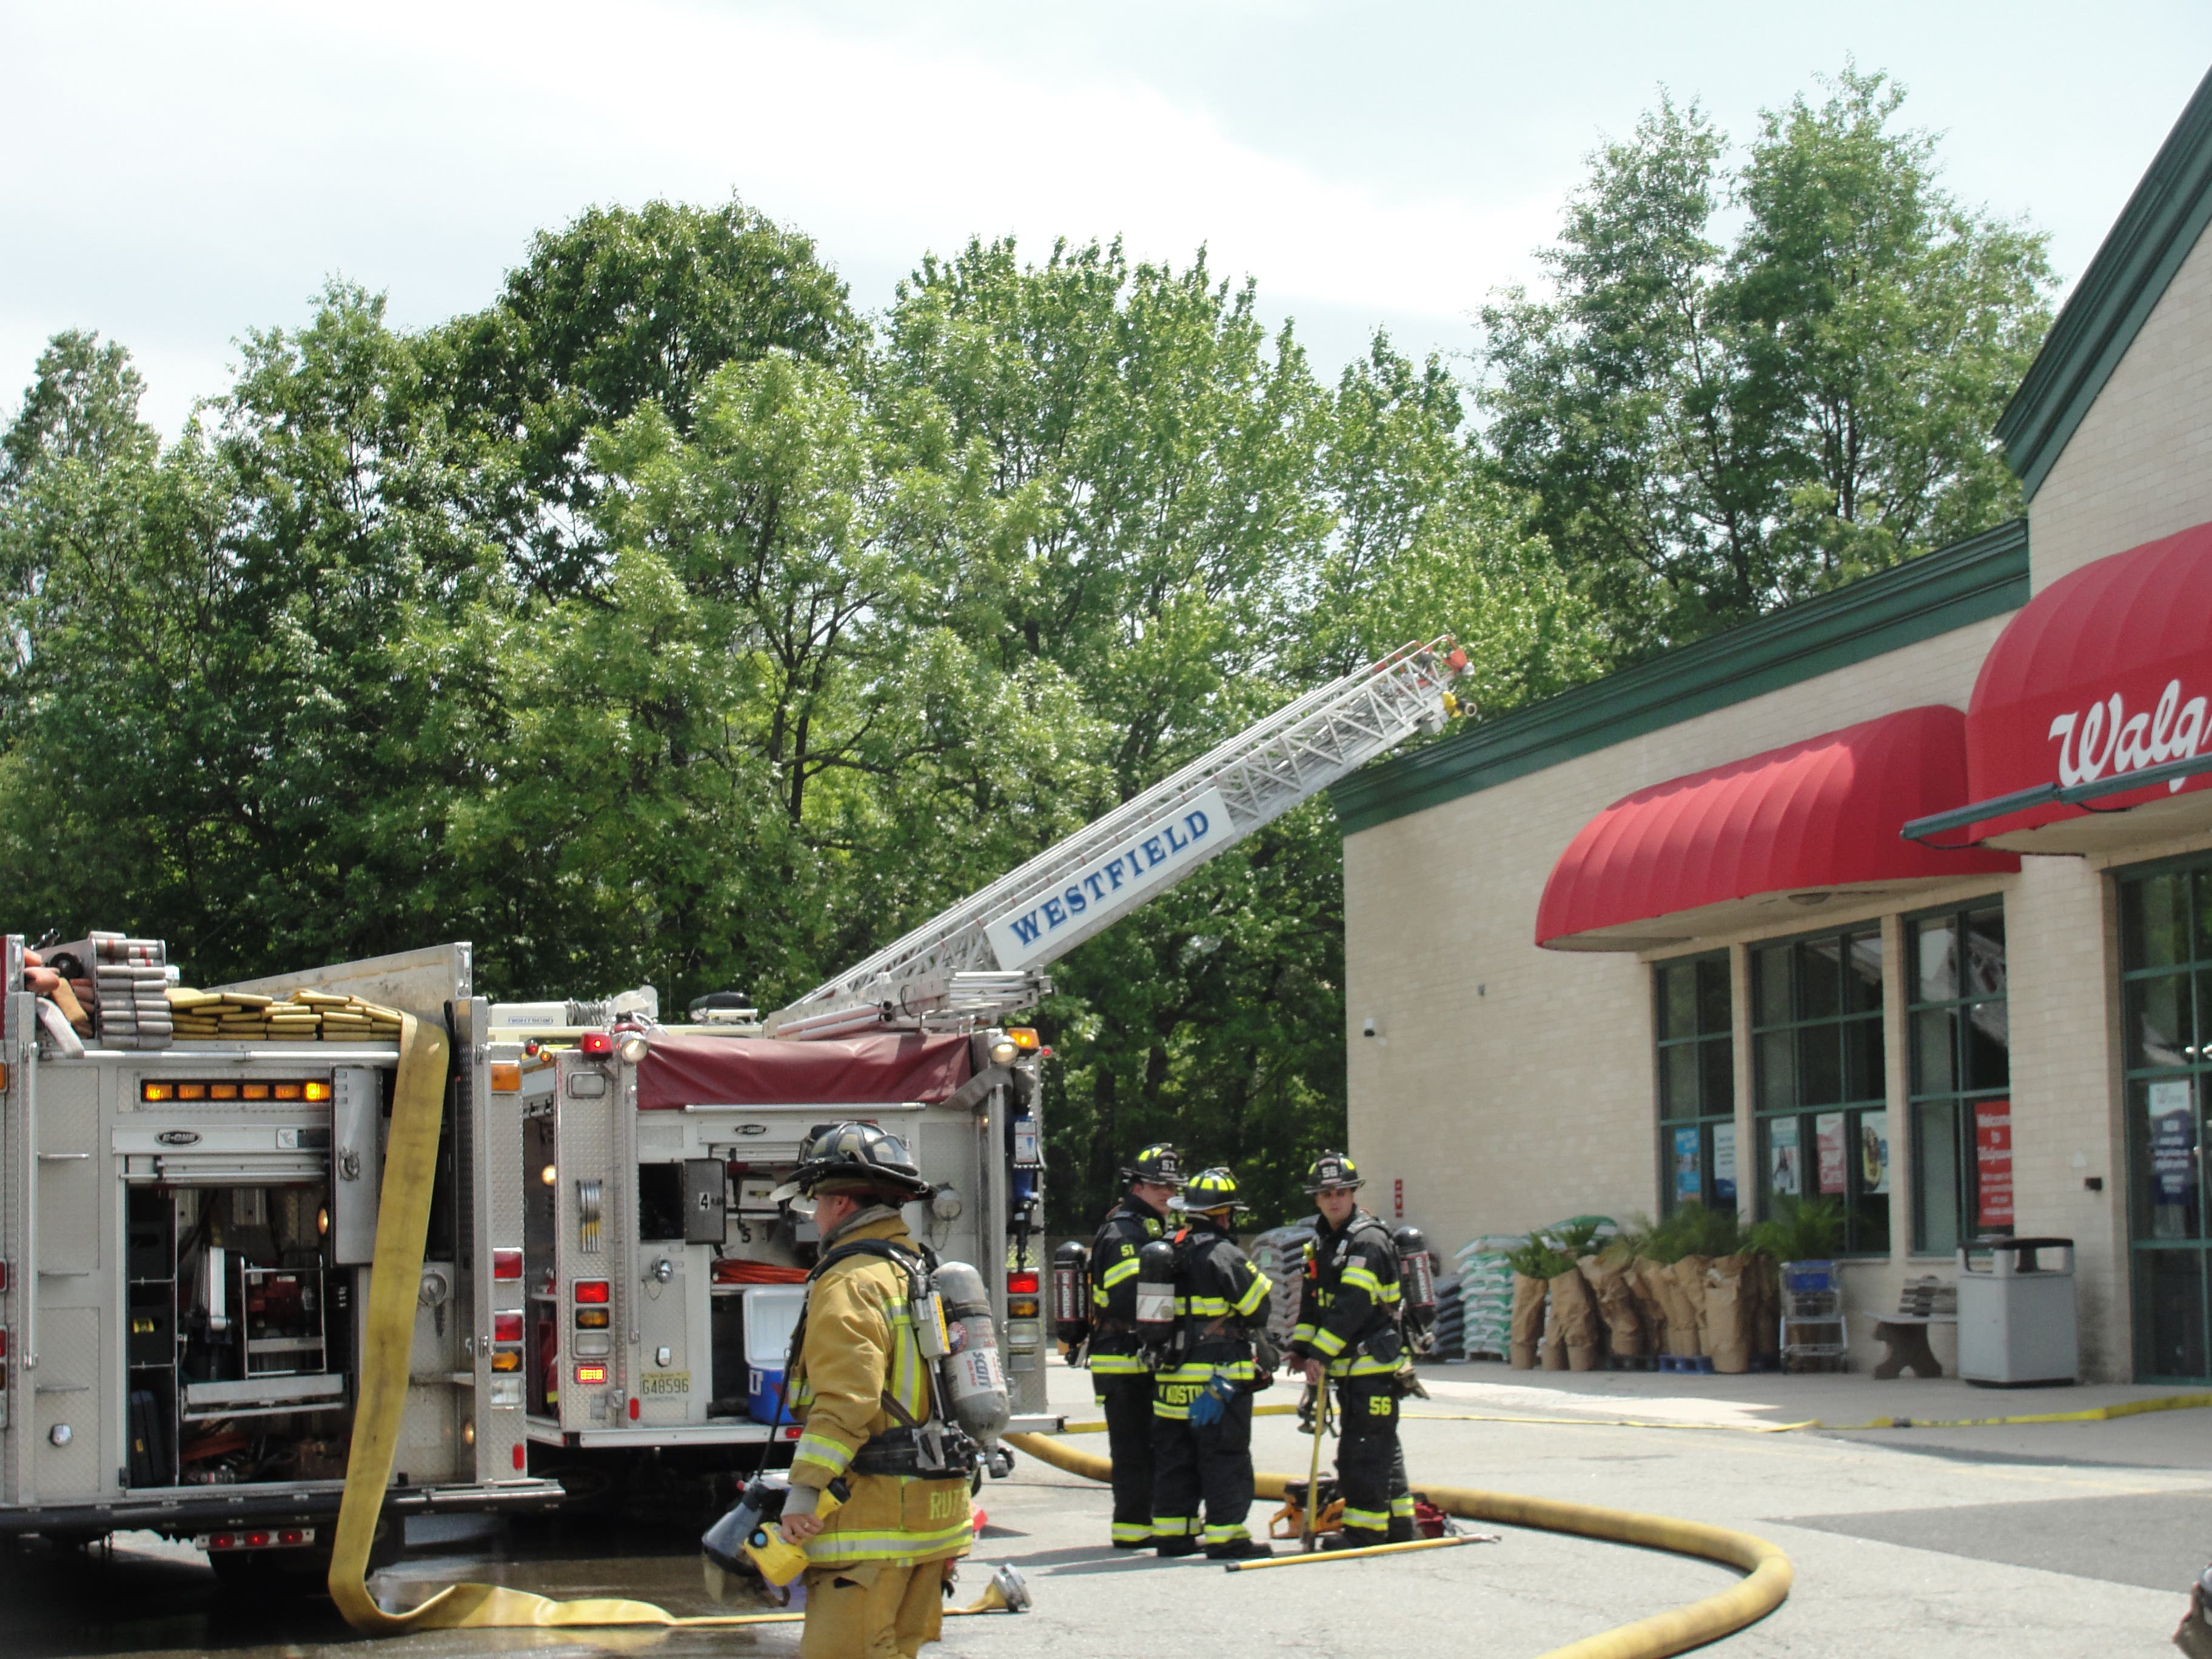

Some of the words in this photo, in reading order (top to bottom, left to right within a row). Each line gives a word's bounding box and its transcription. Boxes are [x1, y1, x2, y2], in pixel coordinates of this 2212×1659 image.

[2048, 679, 2212, 793] Walg
[1010, 810, 1209, 947] WESTFIELD
[701, 1194, 708, 1209] 4
[973, 1352, 991, 1388] SCOTT
[1369, 1396, 1392, 1416] 56
